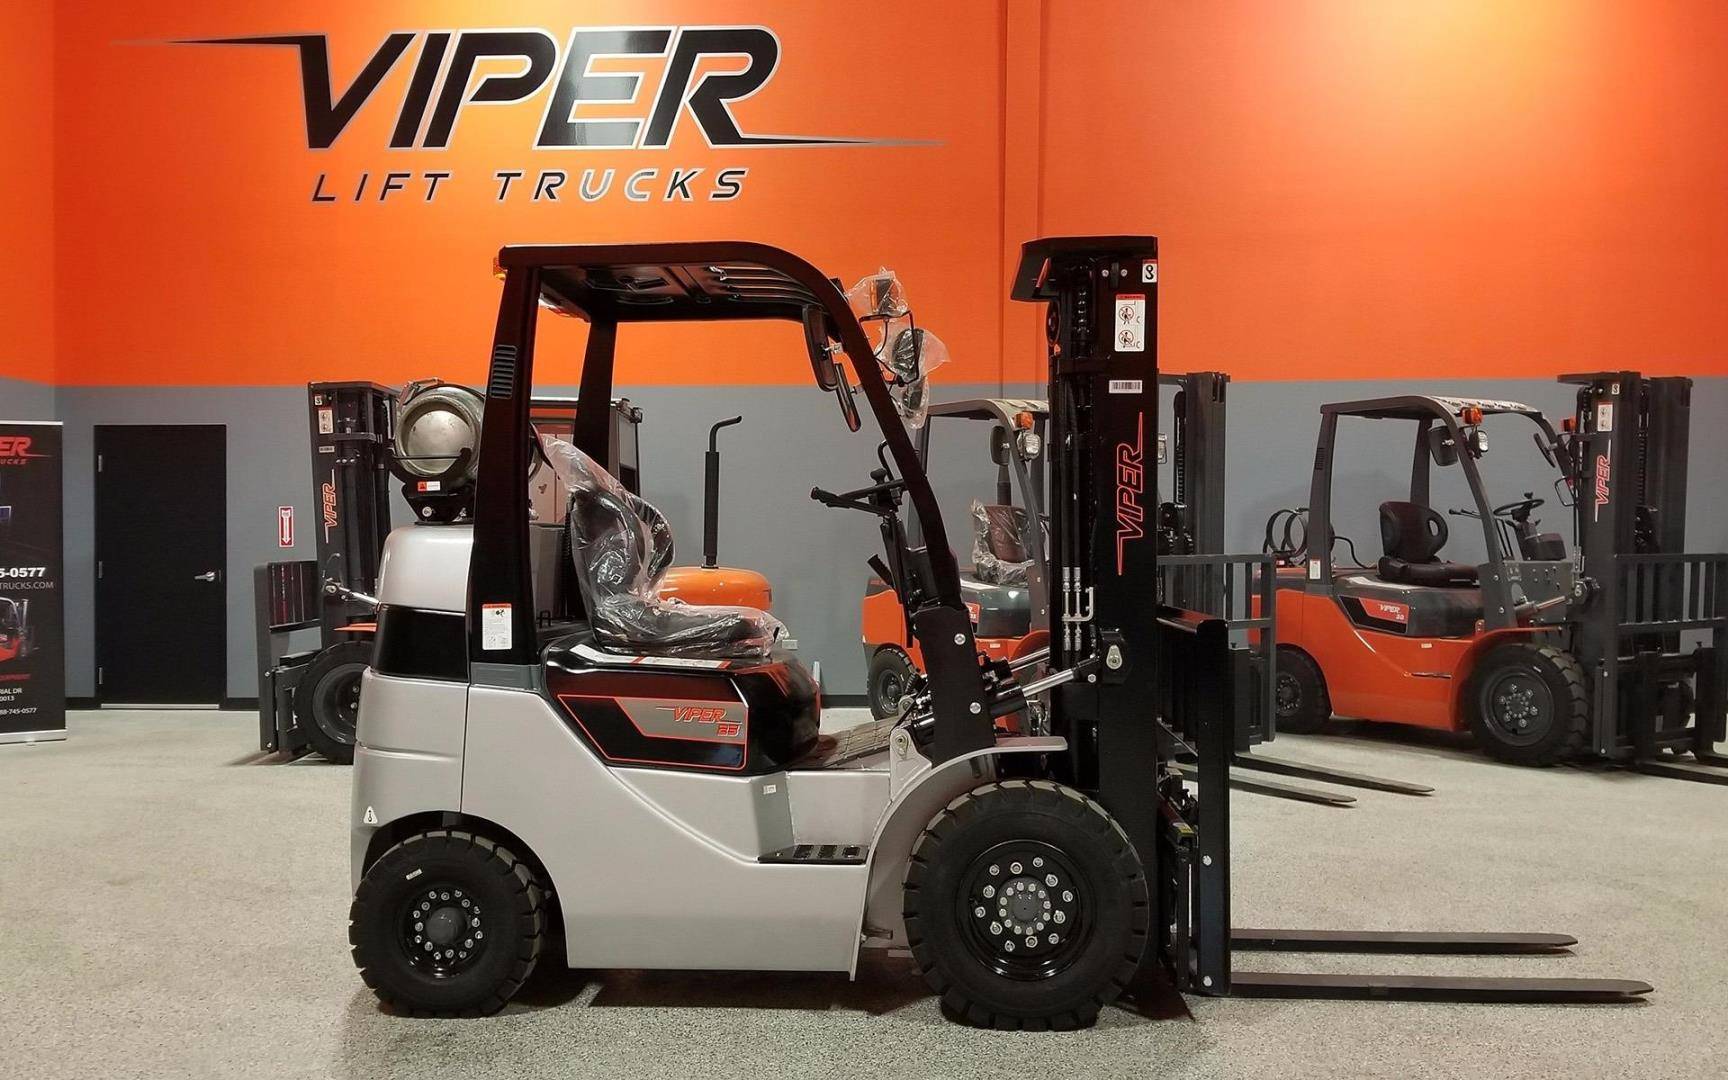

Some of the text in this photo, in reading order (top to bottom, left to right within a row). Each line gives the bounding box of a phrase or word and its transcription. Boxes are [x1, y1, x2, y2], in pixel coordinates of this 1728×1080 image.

[298, 25, 782, 150] VIPER
[311, 167, 749, 203] LIFT TRUCKS
[1116, 441, 1143, 539] VIPER
[1595, 453, 1612, 507] VIPER
[322, 481, 337, 529] VIPER
[0, 567, 46, 579] 5-0577
[673, 706, 727, 723] VIPER
